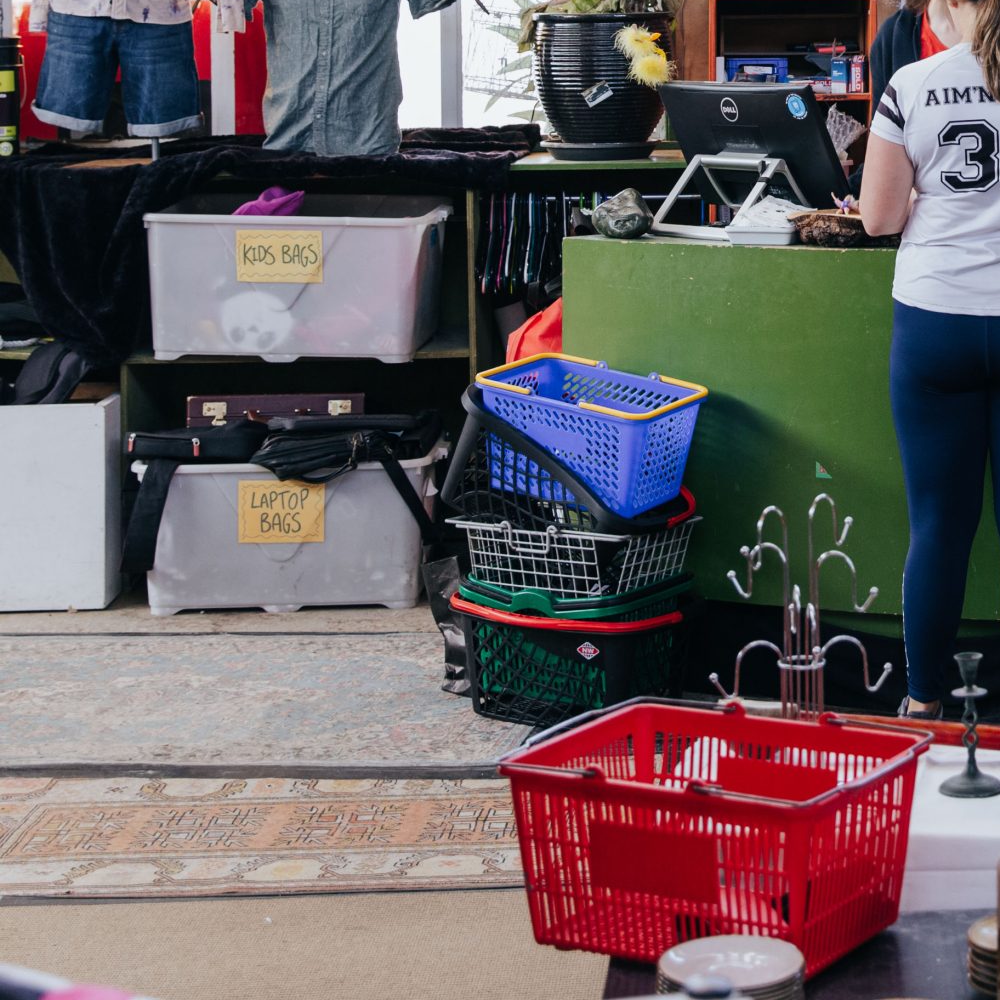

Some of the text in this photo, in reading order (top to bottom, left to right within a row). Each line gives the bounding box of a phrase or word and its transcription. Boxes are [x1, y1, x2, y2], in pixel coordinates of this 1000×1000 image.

[722, 106, 736, 114] DELL
[243, 243, 318, 268] KIDS BAGS
[251, 488, 309, 510] LAPTOP
[260, 512, 302, 534] BAGS
